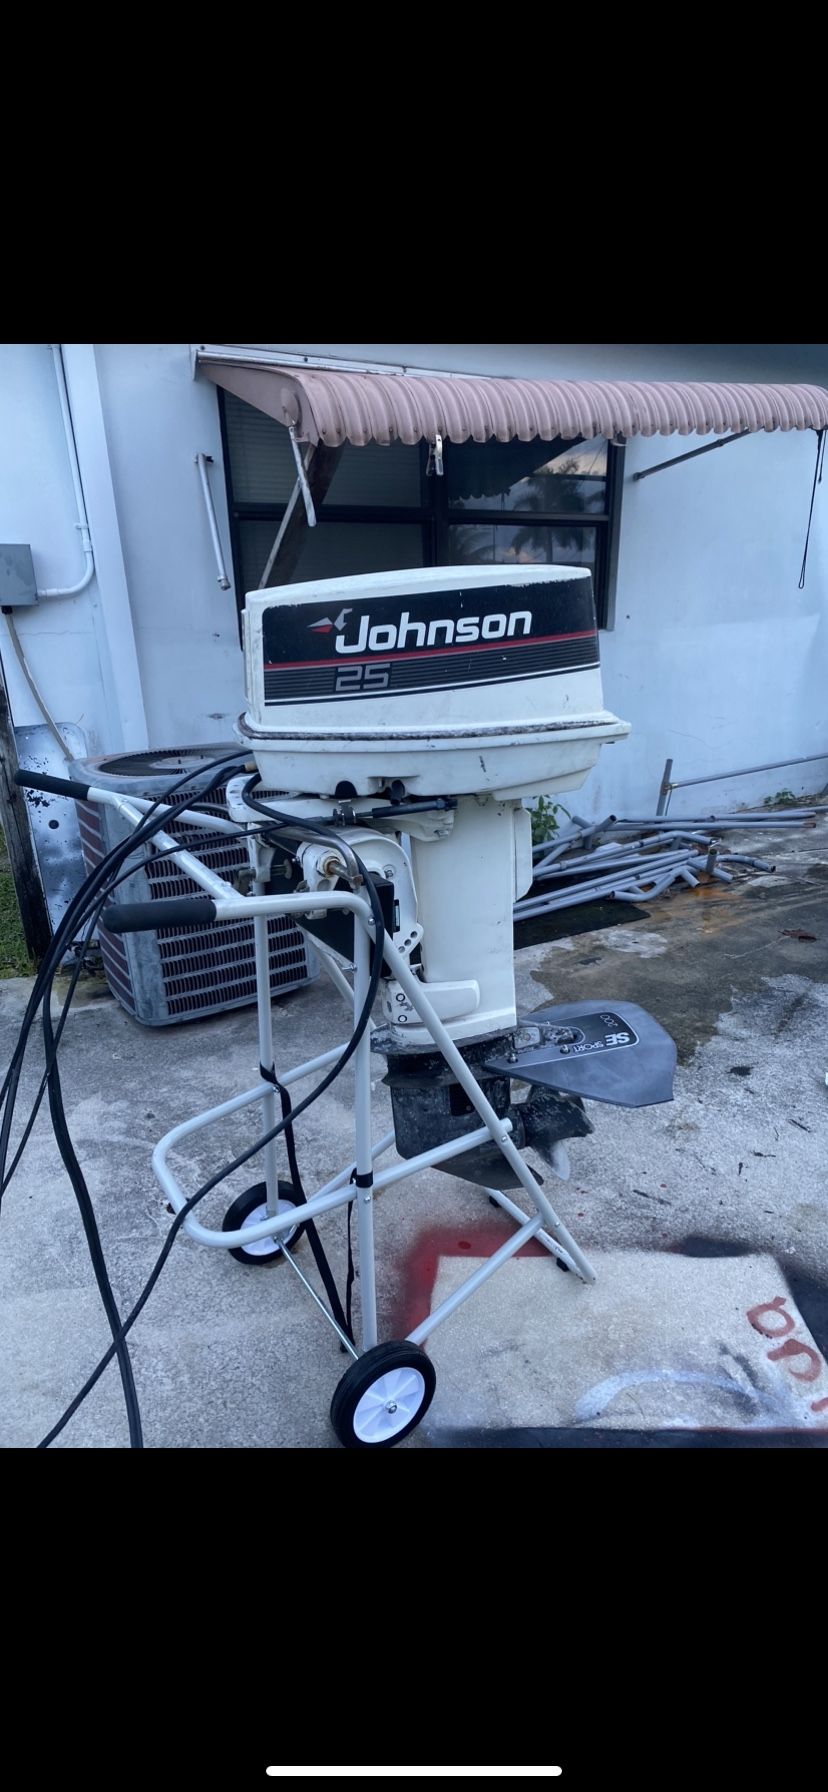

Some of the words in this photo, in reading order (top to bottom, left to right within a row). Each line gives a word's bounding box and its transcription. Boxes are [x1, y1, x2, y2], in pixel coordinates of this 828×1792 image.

[335, 610, 532, 655] Johnson
[335, 663, 391, 692] 25
[573, 1040, 604, 1053] SPORT
[604, 1031, 630, 1046] SE
